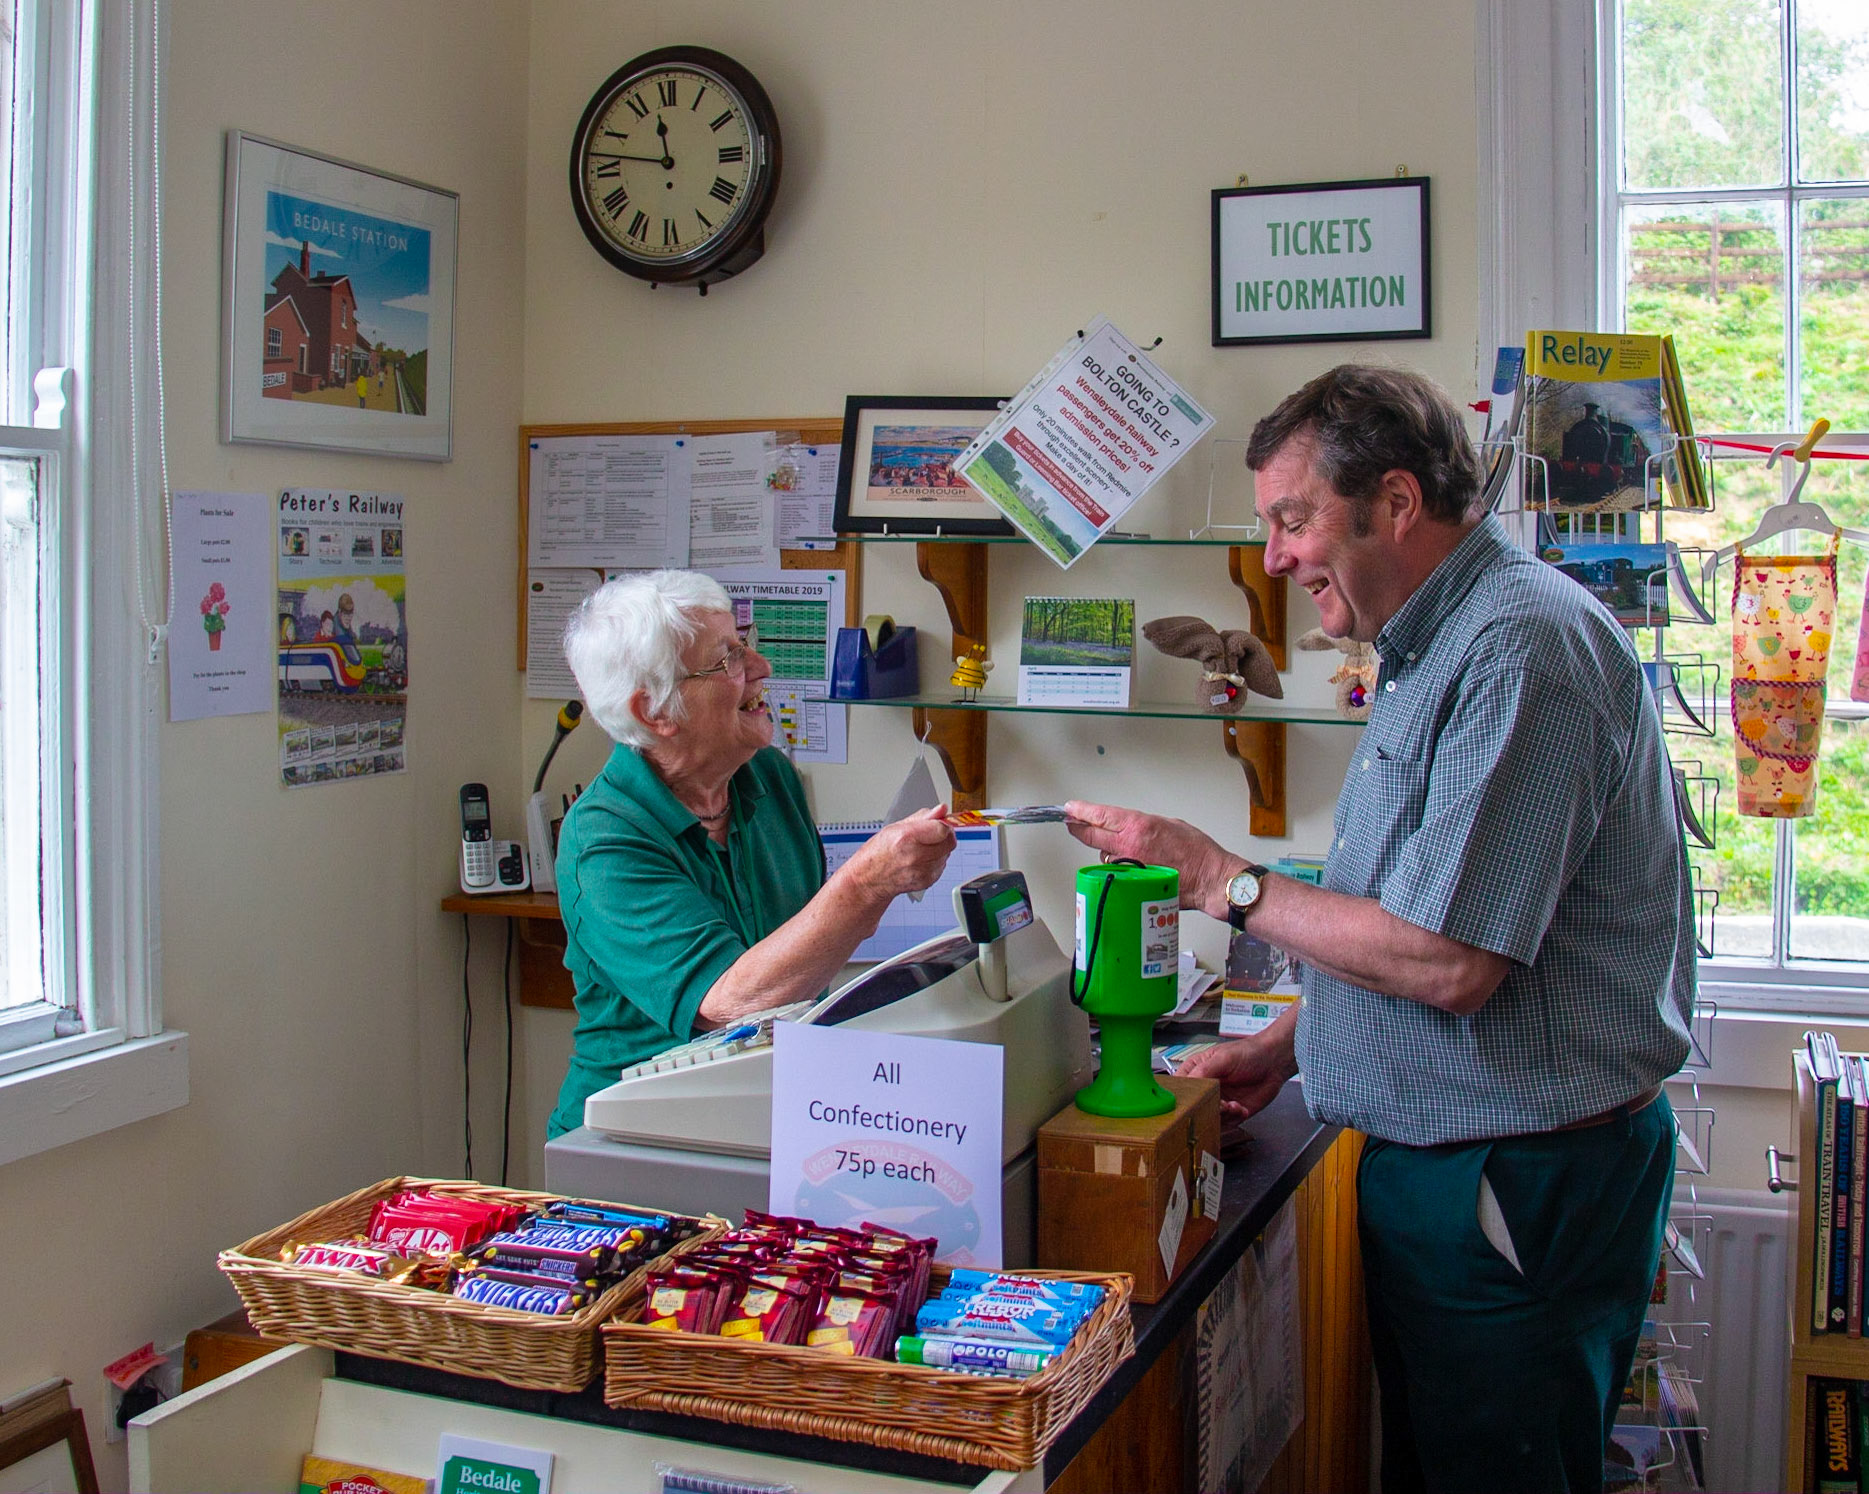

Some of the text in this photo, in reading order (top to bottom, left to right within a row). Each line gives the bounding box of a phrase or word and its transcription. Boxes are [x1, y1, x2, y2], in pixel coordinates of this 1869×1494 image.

[294, 212, 408, 252] BEDALE STATION
[1266, 217, 1372, 257] TICKETS
[1235, 275, 1405, 313] INFORMATION
[1542, 335, 1612, 374] Relay
[263, 372, 286, 387] BEDALE
[1081, 355, 1129, 401] BOLTON
[1126, 399, 1170, 441] CASTLE
[1115, 364, 1154, 402] GOING
[1151, 398, 1170, 417] TO
[1057, 384, 1153, 474] passengers get 20% off
[1074, 376, 1127, 427] Wensleydale
[1125, 424, 1158, 457] Railway
[1032, 403, 1131, 497] Only 20 minutes walk from Redmire
[1036, 420, 1059, 444] through
[1059, 441, 1085, 467] excellent
[1084, 466, 1109, 491] scenery
[1060, 405, 1129, 473] admission prices!
[1013, 431, 1024, 442] Buy
[1022, 440, 1033, 451] your
[1033, 448, 1050, 465] tickets
[1053, 468, 1073, 488] advance
[1072, 486, 1085, 498] from
[1083, 496, 1093, 506] the
[1092, 504, 1104, 517] Train
[1015, 444, 1030, 459] Guard
[1053, 479, 1063, 490] Bar
[1062, 487, 1076, 502] ticket
[1045, 441, 1062, 458] Make
[1065, 460, 1078, 474] day
[1076, 471, 1085, 480] of
[280, 492, 403, 520] Peter's Railway
[890, 488, 966, 496] SCARBOROUGH
[724, 585, 823, 595] LWAY TIMETABLE 2019
[872, 1062, 901, 1085] All
[809, 1100, 967, 1145] Confectionery
[835, 1150, 935, 1184] 75p each
[1823, 1141, 1833, 1180] TRAIN
[1838, 1127, 1849, 1172] YEARS
[1838, 1174, 1848, 1192] OF
[1853, 1109, 1867, 1256] British Railfreight Today and Tomorrow
[1820, 1181, 1831, 1232] TRAVEL
[1837, 1195, 1848, 1227] BRITISH
[295, 1248, 388, 1274] TWIX
[541, 1258, 576, 1273] SNICKERS
[1834, 1229, 1847, 1296] RAILWAYS
[459, 1278, 571, 1315] SNICKERS
[963, 1299, 1036, 1320] TREBOR
[965, 1345, 1008, 1359] POLO
[1826, 1390, 1849, 1472] RAILWAYS
[342, 1482, 383, 1494] POCKET
[459, 1465, 521, 1493] Bedale
